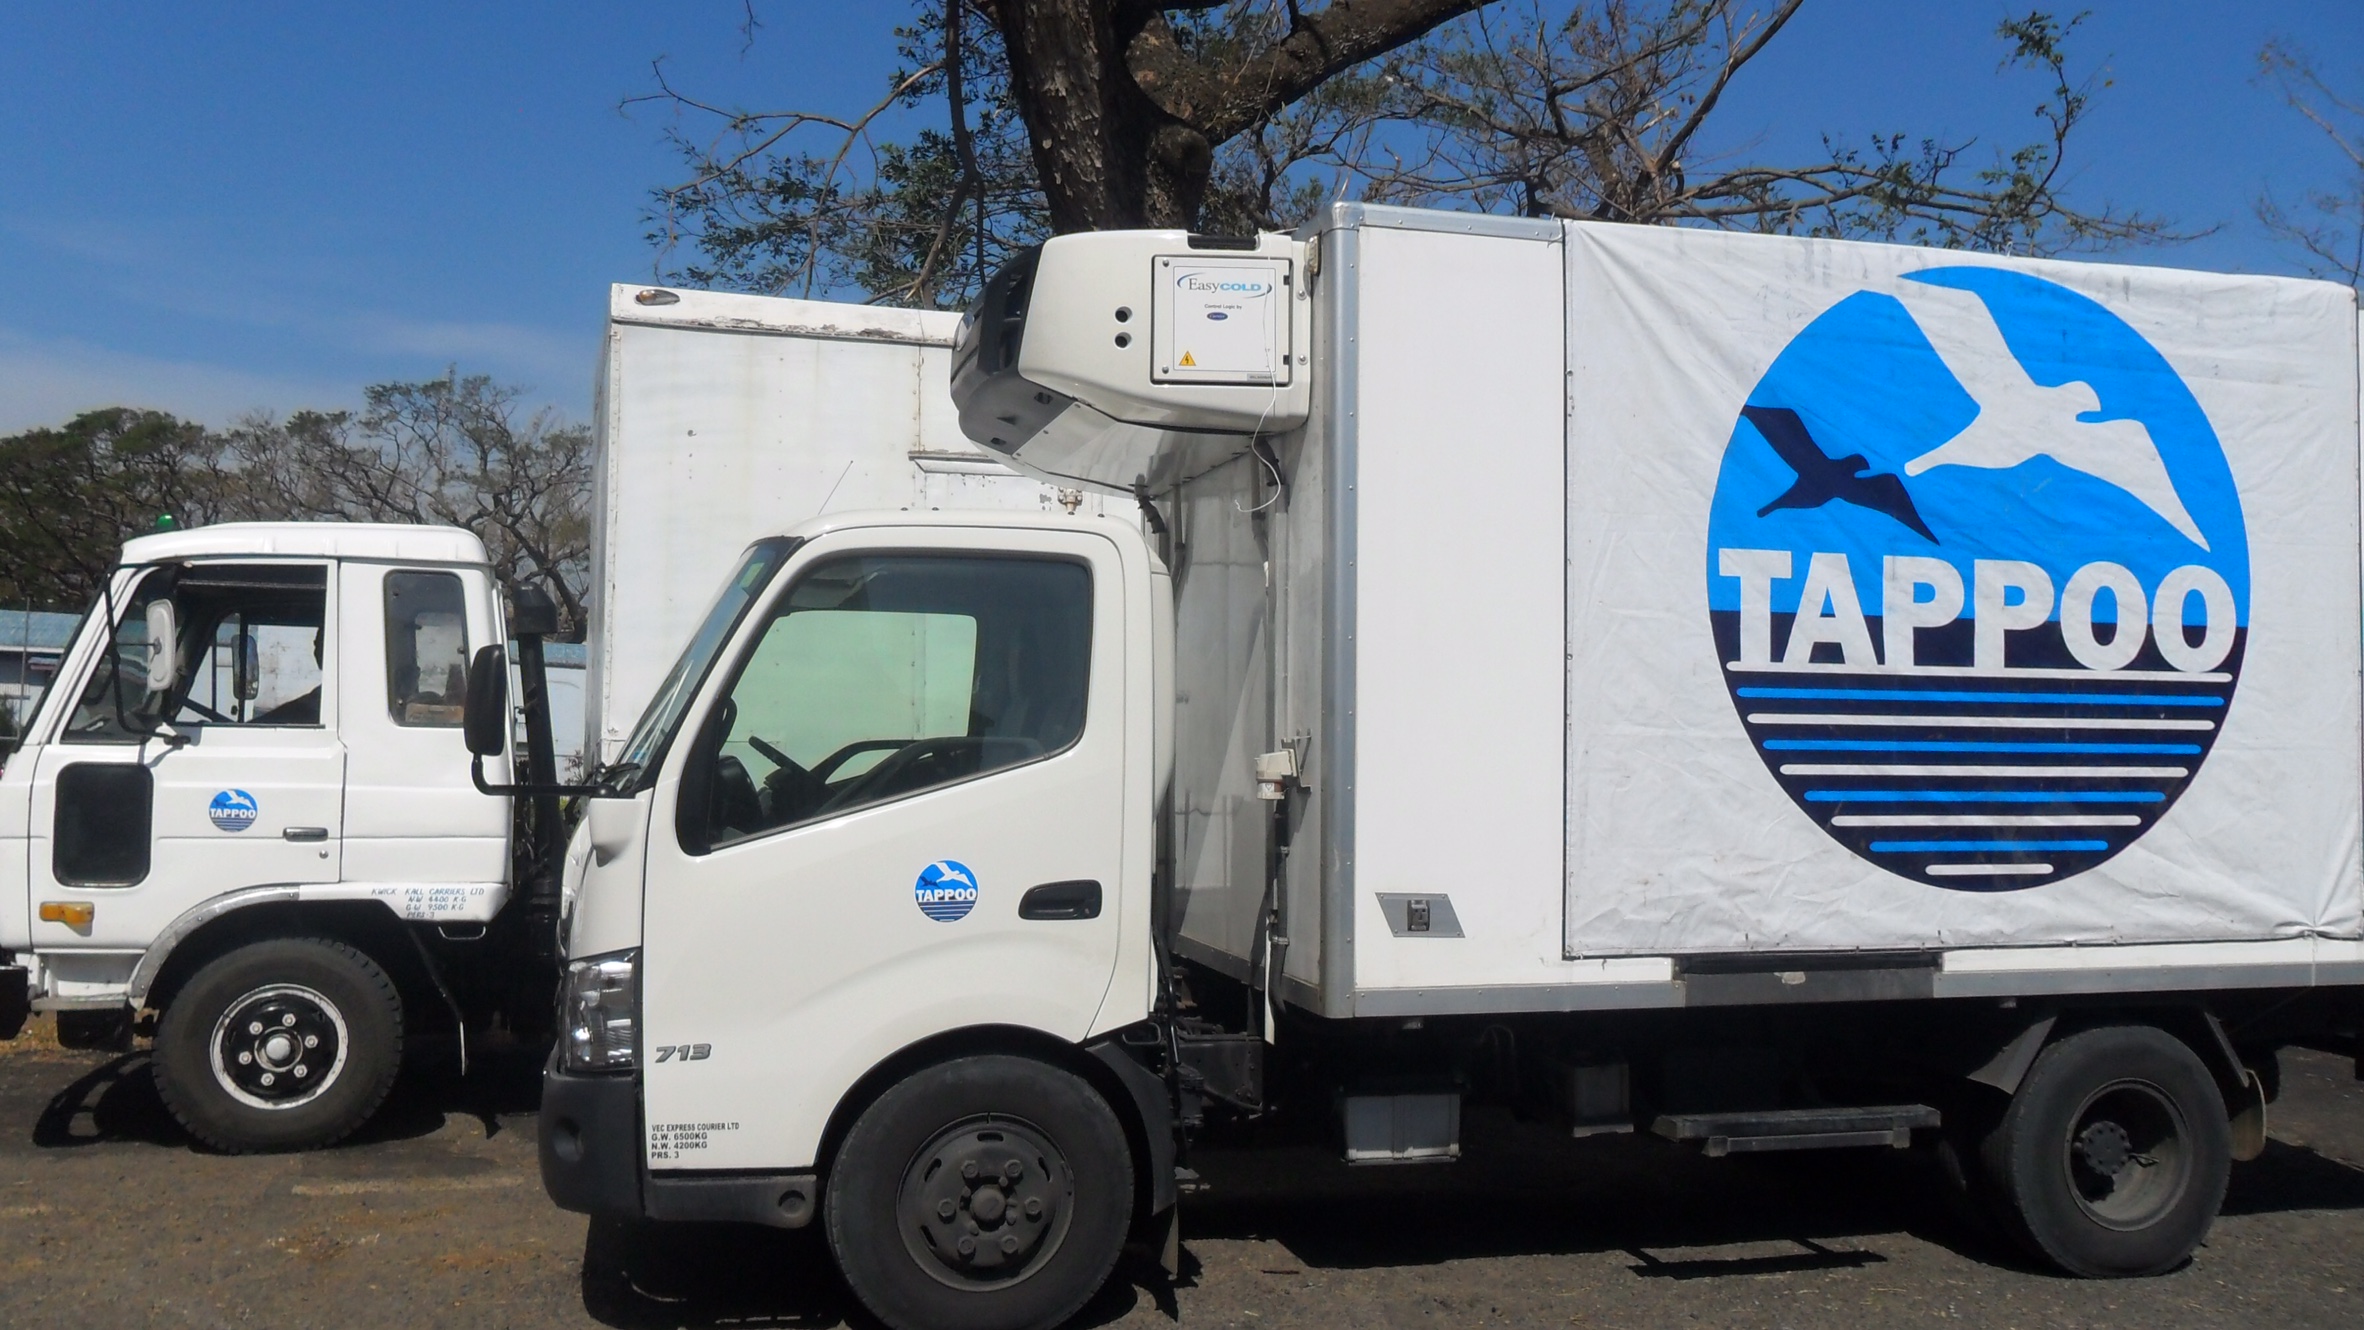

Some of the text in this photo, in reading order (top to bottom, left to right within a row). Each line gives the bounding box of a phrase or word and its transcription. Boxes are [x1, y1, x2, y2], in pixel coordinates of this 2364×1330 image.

[1188, 278, 1262, 293] EasyCOLD
[1718, 548, 2237, 673] TAPPOO
[210, 808, 256, 819] TAPPOO
[916, 887, 977, 902] TAPPOO
[655, 1043, 712, 1064] 713
[651, 1122, 740, 1132] VEC EXPRESS COURIER LTD
[651, 1132, 708, 1141] G.W. 6500KG
[651, 1141, 708, 1150] N.W. 4200KG
[651, 1151, 680, 1159] PRS. 3
